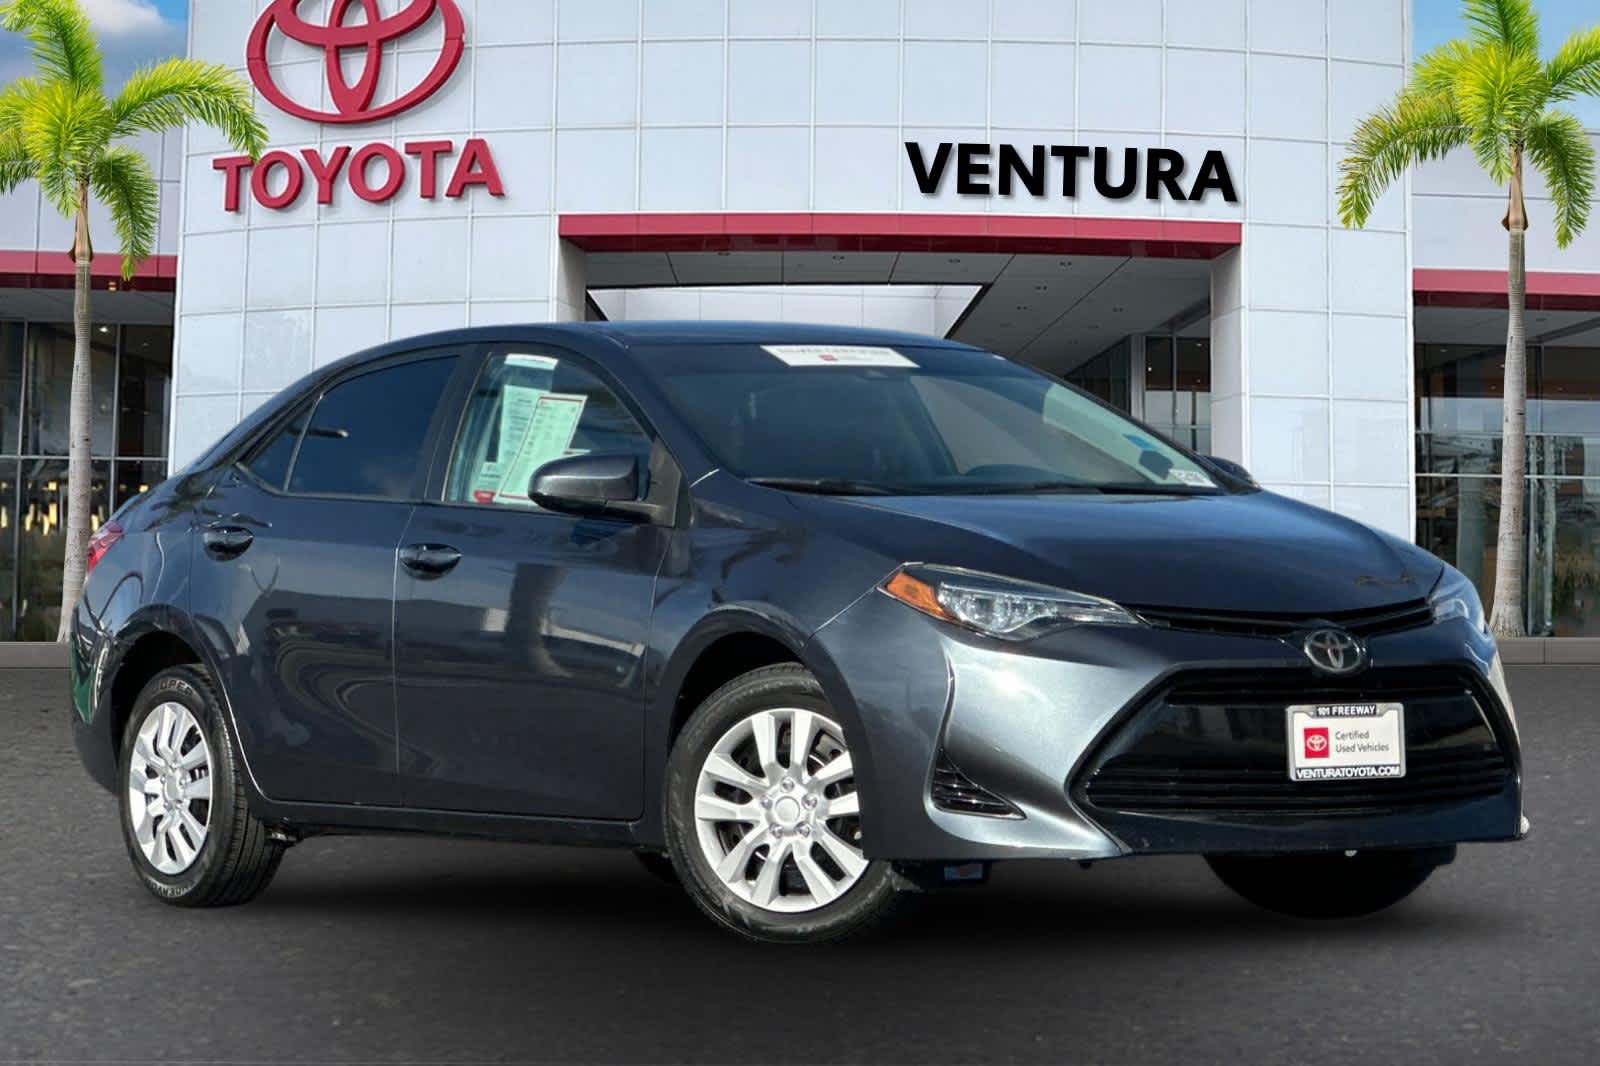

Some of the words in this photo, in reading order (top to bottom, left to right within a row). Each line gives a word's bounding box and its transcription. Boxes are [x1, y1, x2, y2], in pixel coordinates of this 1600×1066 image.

[212, 138, 505, 212] TOYOTA
[904, 141, 1238, 202] VENTURA
[1331, 706, 1375, 715] FREEWAY
[1335, 731, 1369, 740] Certified
[1335, 744, 1356, 752] Used
[1357, 743, 1389, 752] Vehicles
[1296, 766, 1400, 779] VENTURATOYOTA.COM
